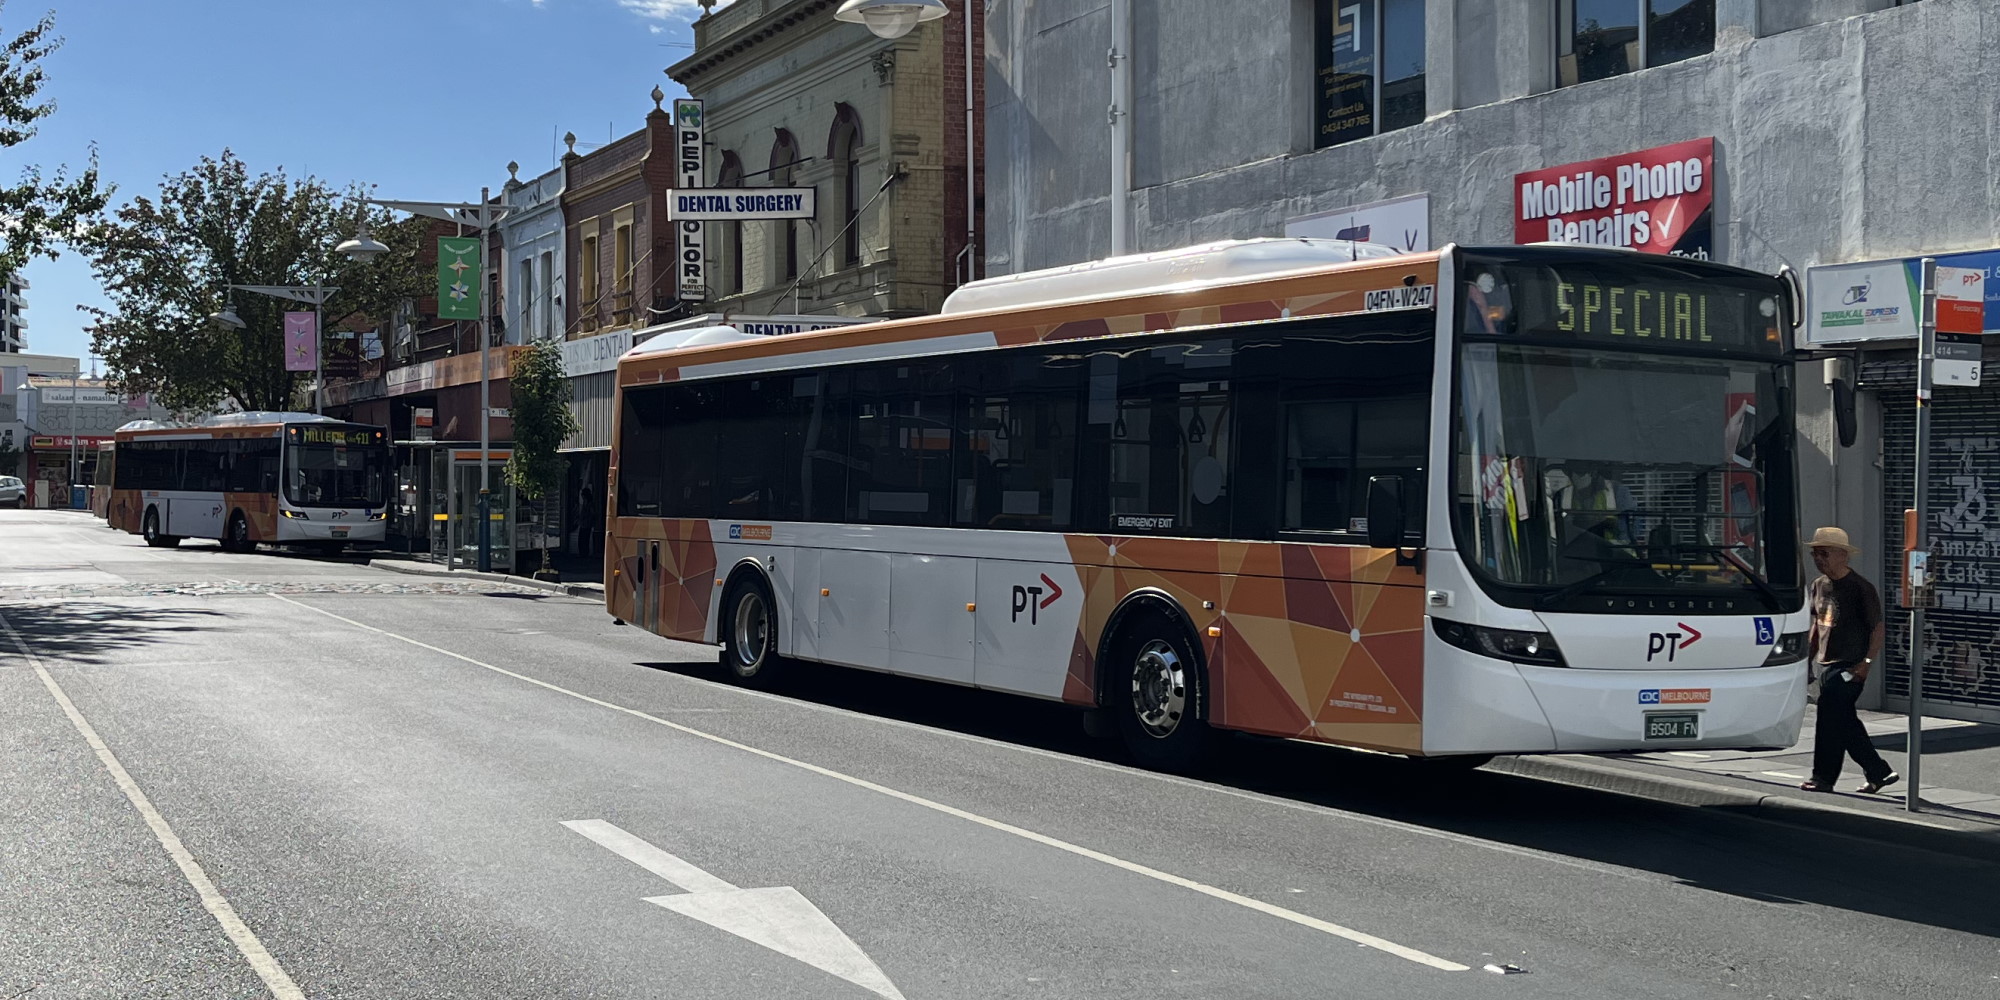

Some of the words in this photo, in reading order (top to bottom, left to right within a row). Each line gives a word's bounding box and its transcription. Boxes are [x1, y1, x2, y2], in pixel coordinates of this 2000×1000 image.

[1327, 105, 1353, 118] Contact
[1354, 101, 1364, 112] Us
[1522, 171, 1611, 220] Mobile
[1616, 157, 1703, 205] Phone
[678, 195, 732, 212] DENTAL
[736, 194, 803, 212] SURGERY
[1367, 286, 1432, 311] 04FN-W247
[1557, 283, 1712, 342] SPECIAL
[1821, 309, 1864, 320] TAWAKAL
[1865, 307, 1899, 317] EXPRESS
[593, 333, 628, 361] DENTAL
[1936, 346, 1951, 355] 414
[1970, 367, 1978, 380] 5
[1118, 516, 1157, 528] EMERGENCY
[1158, 517, 1173, 528] EXIT
[1606, 600, 1734, 609] VOLGREN
[1640, 691, 1659, 701] CDC
[1661, 691, 1710, 701] MELBOURNE
[1650, 722, 1678, 736] BS04
[1683, 722, 1698, 736] FN
